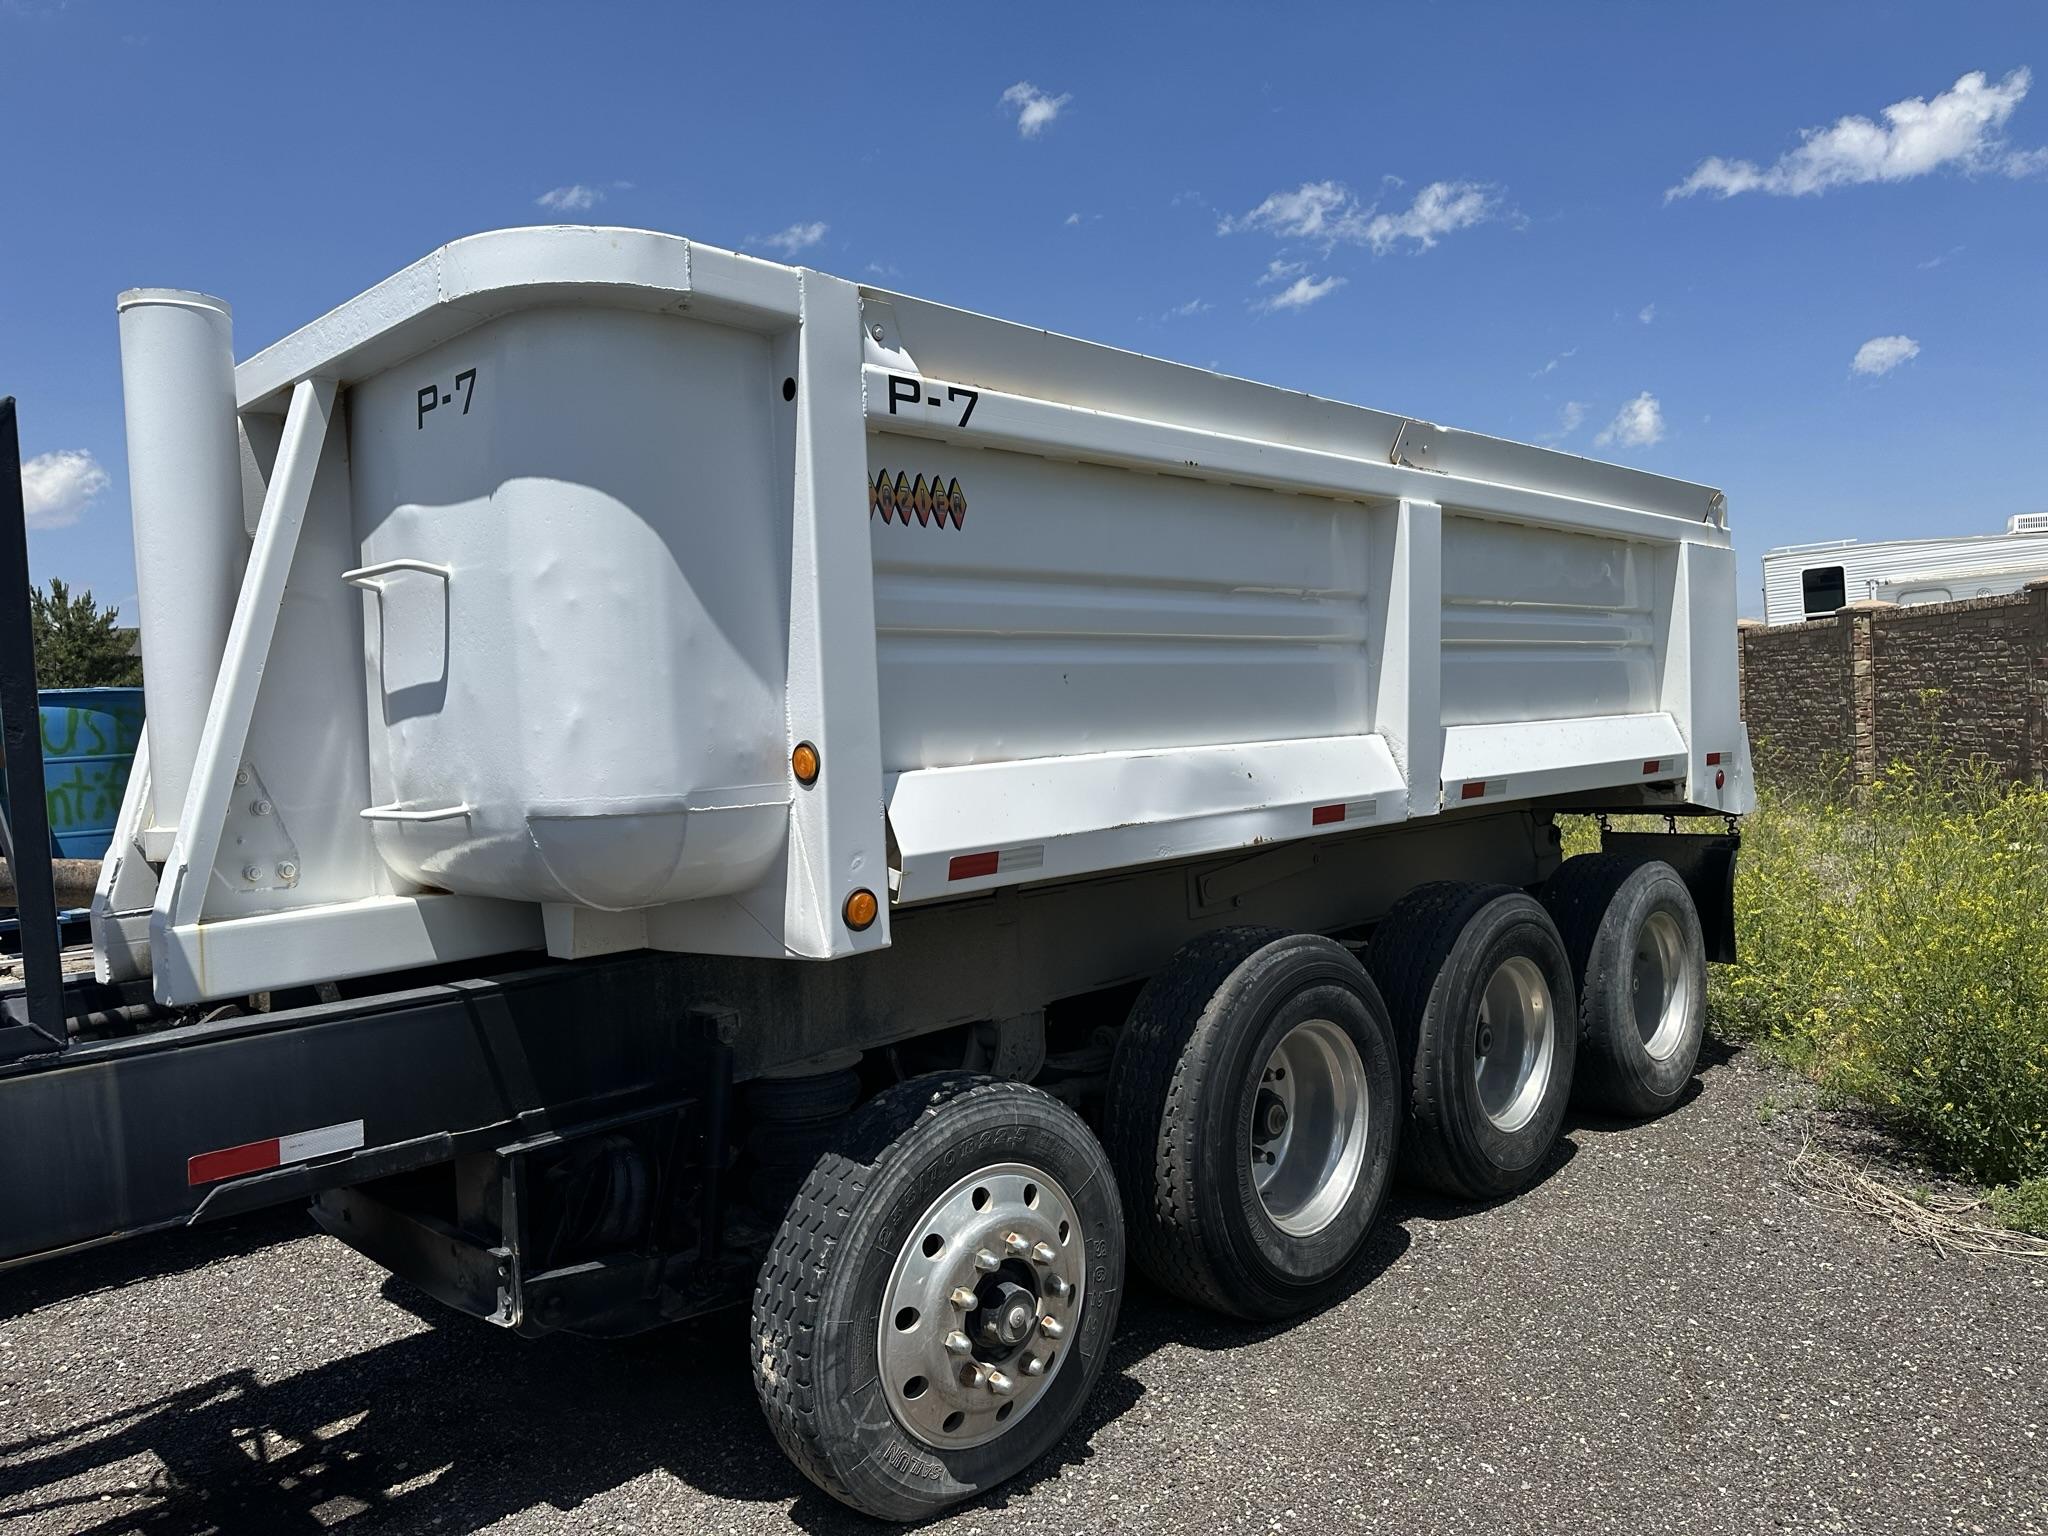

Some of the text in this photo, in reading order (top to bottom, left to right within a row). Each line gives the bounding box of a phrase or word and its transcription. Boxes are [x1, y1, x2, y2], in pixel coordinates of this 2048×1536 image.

[417, 367, 477, 431] P-7
[888, 374, 979, 428] P-7
[868, 478, 964, 519] AZIER
[883, 1440, 943, 1481] SAILUN
